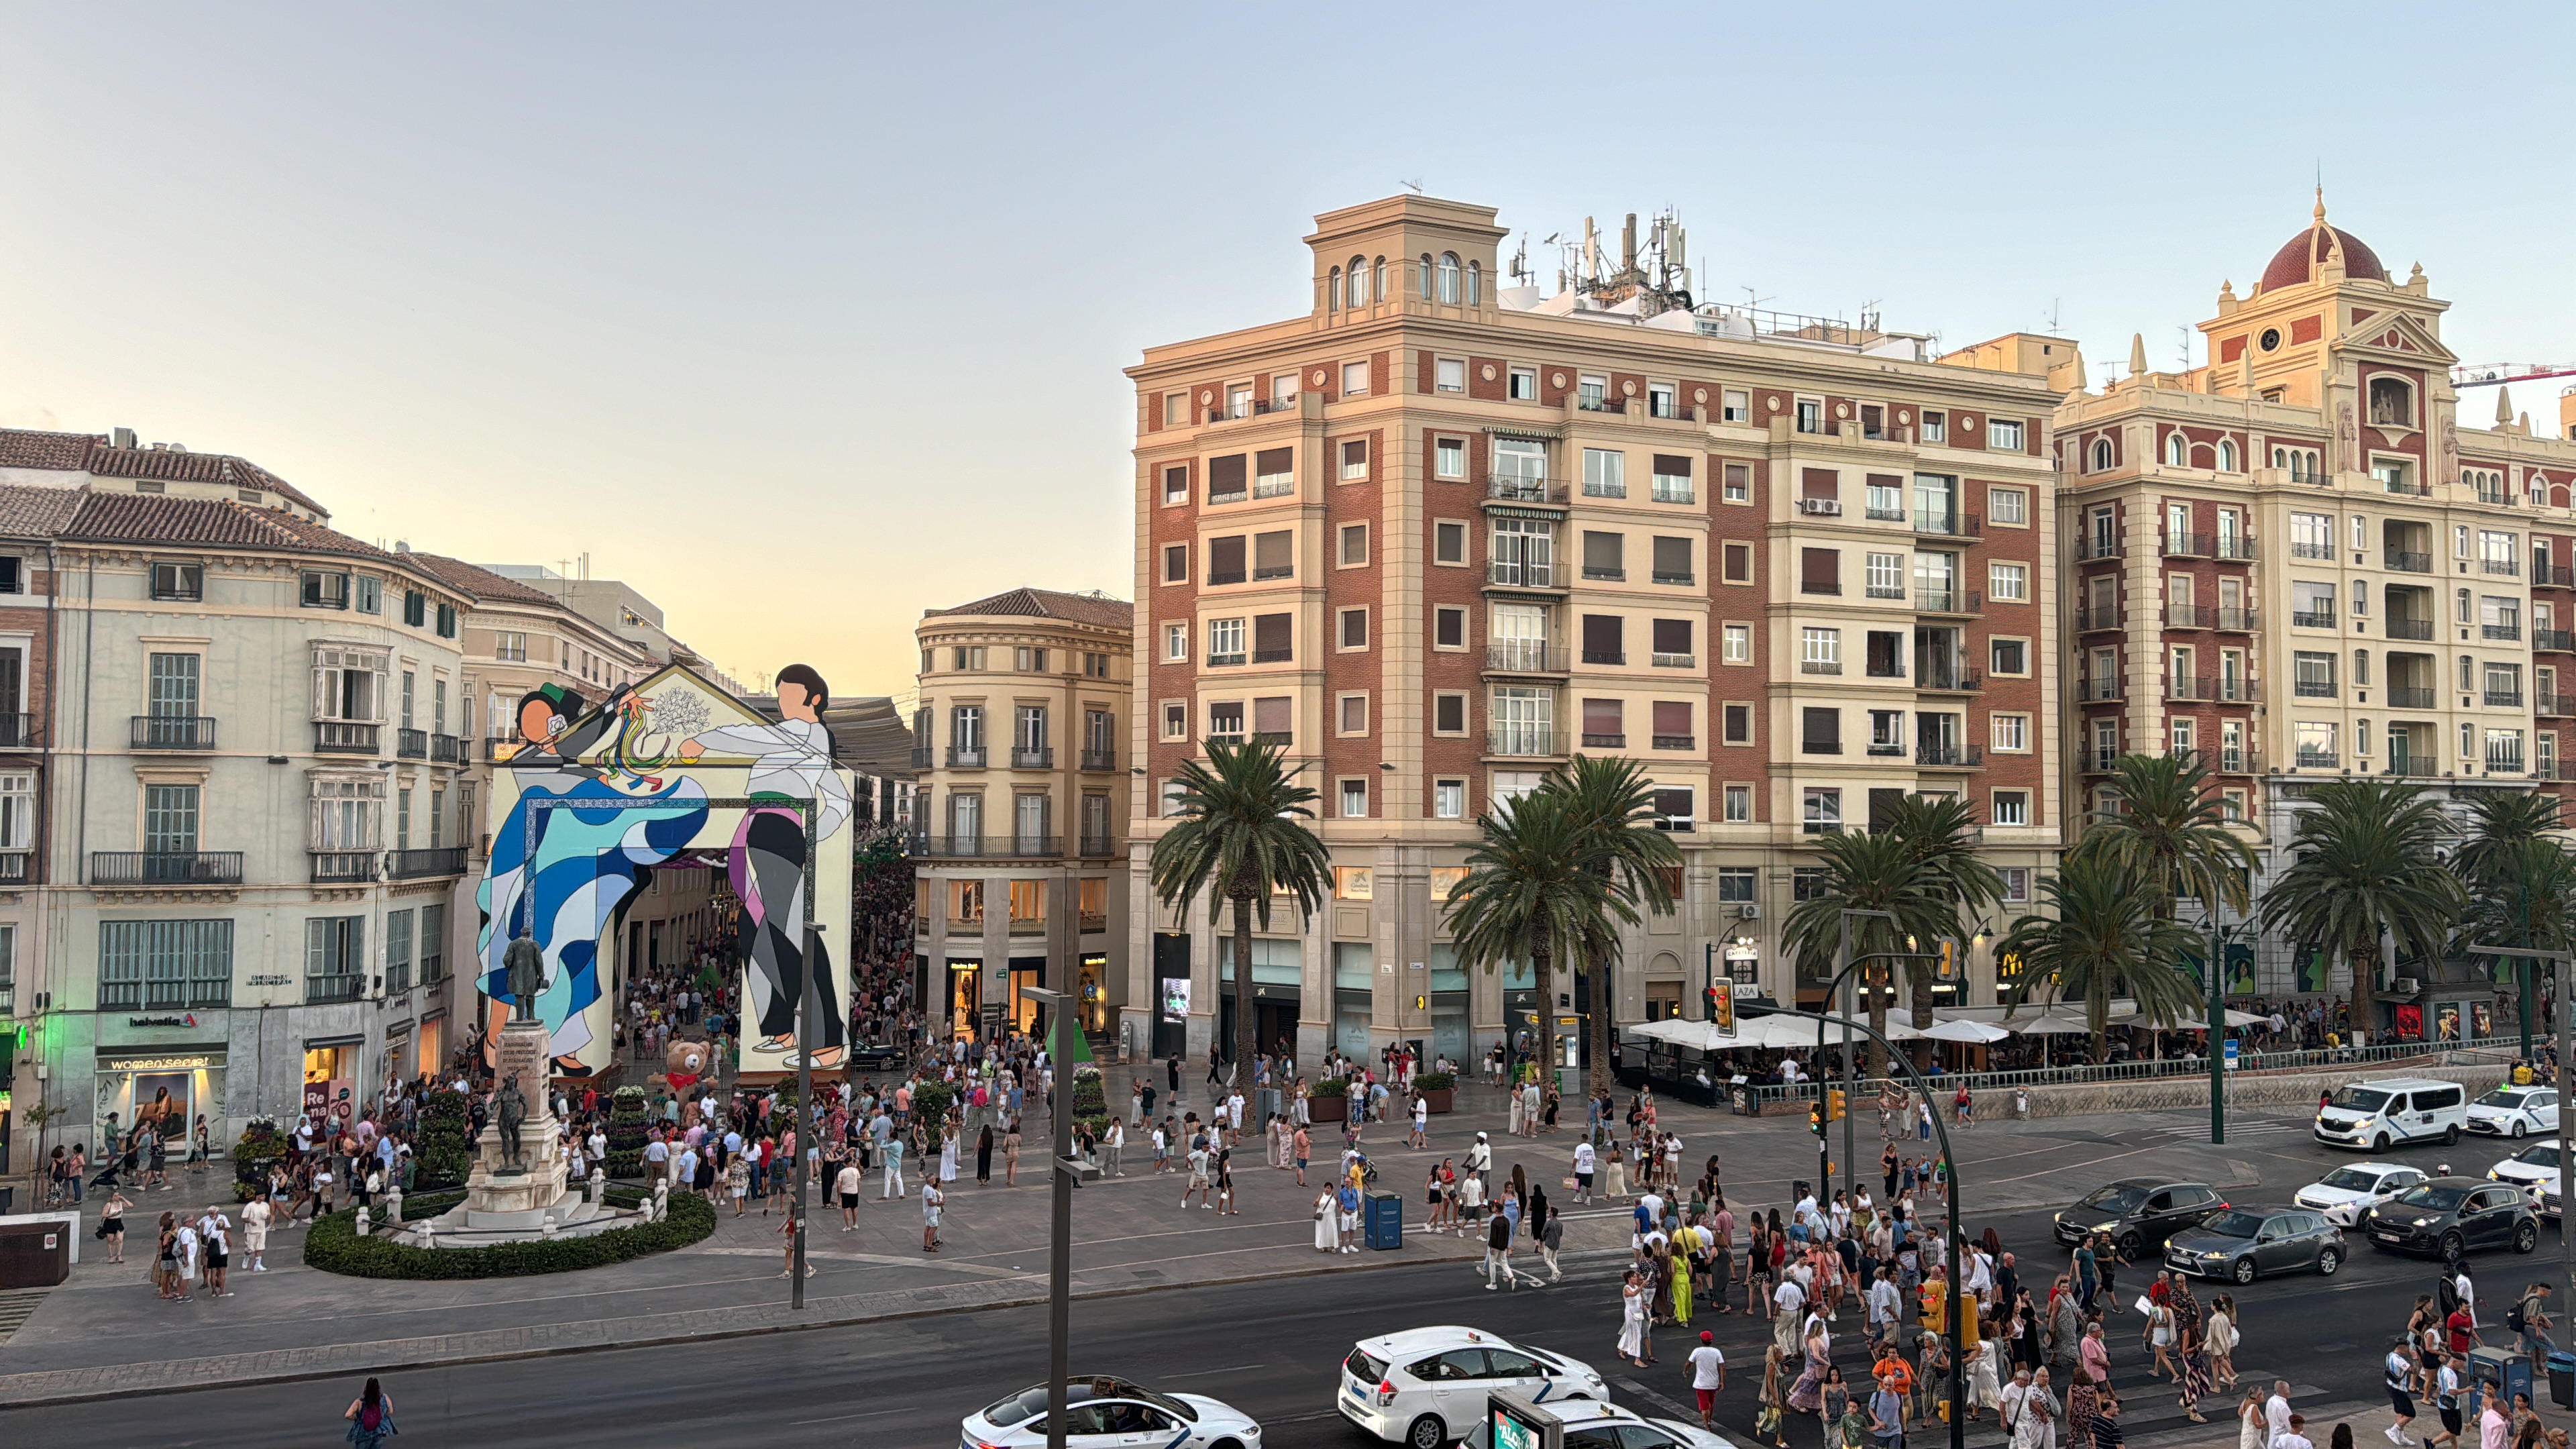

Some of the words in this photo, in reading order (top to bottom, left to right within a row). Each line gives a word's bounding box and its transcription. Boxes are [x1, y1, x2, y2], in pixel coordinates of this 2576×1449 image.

[129, 1016, 180, 1026] helvetia
[111, 1057, 209, 1070] women'secret
[307, 1092, 325, 1106] Re
